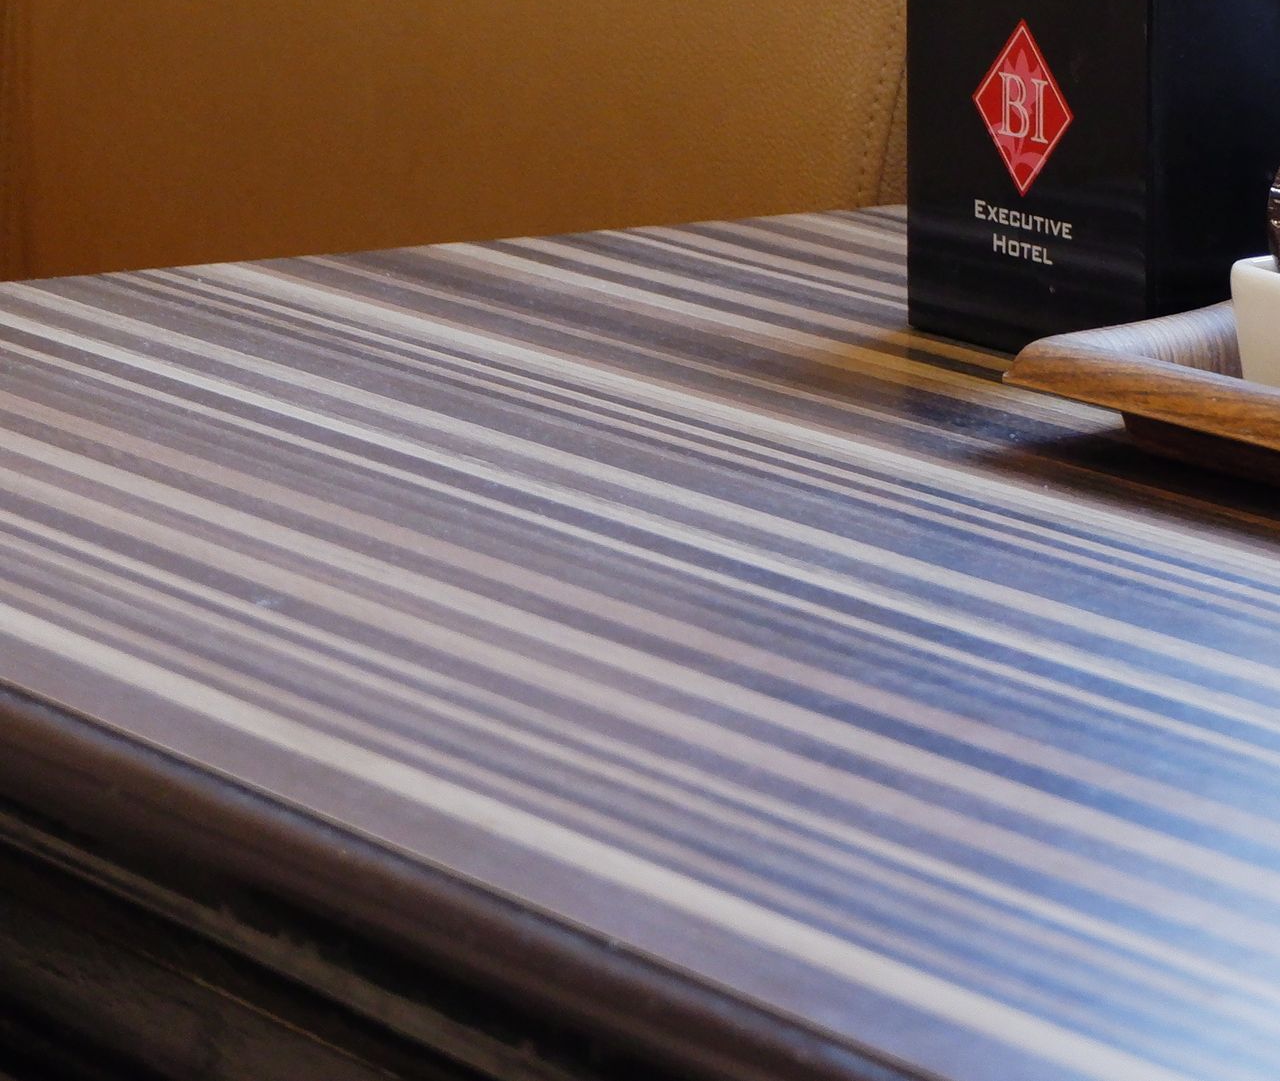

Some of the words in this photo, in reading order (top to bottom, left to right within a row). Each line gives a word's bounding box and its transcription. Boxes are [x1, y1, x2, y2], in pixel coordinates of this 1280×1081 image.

[997, 71, 1049, 144] BI
[974, 198, 1073, 240] EXECUTIVE
[993, 233, 1053, 266] HOTEL
